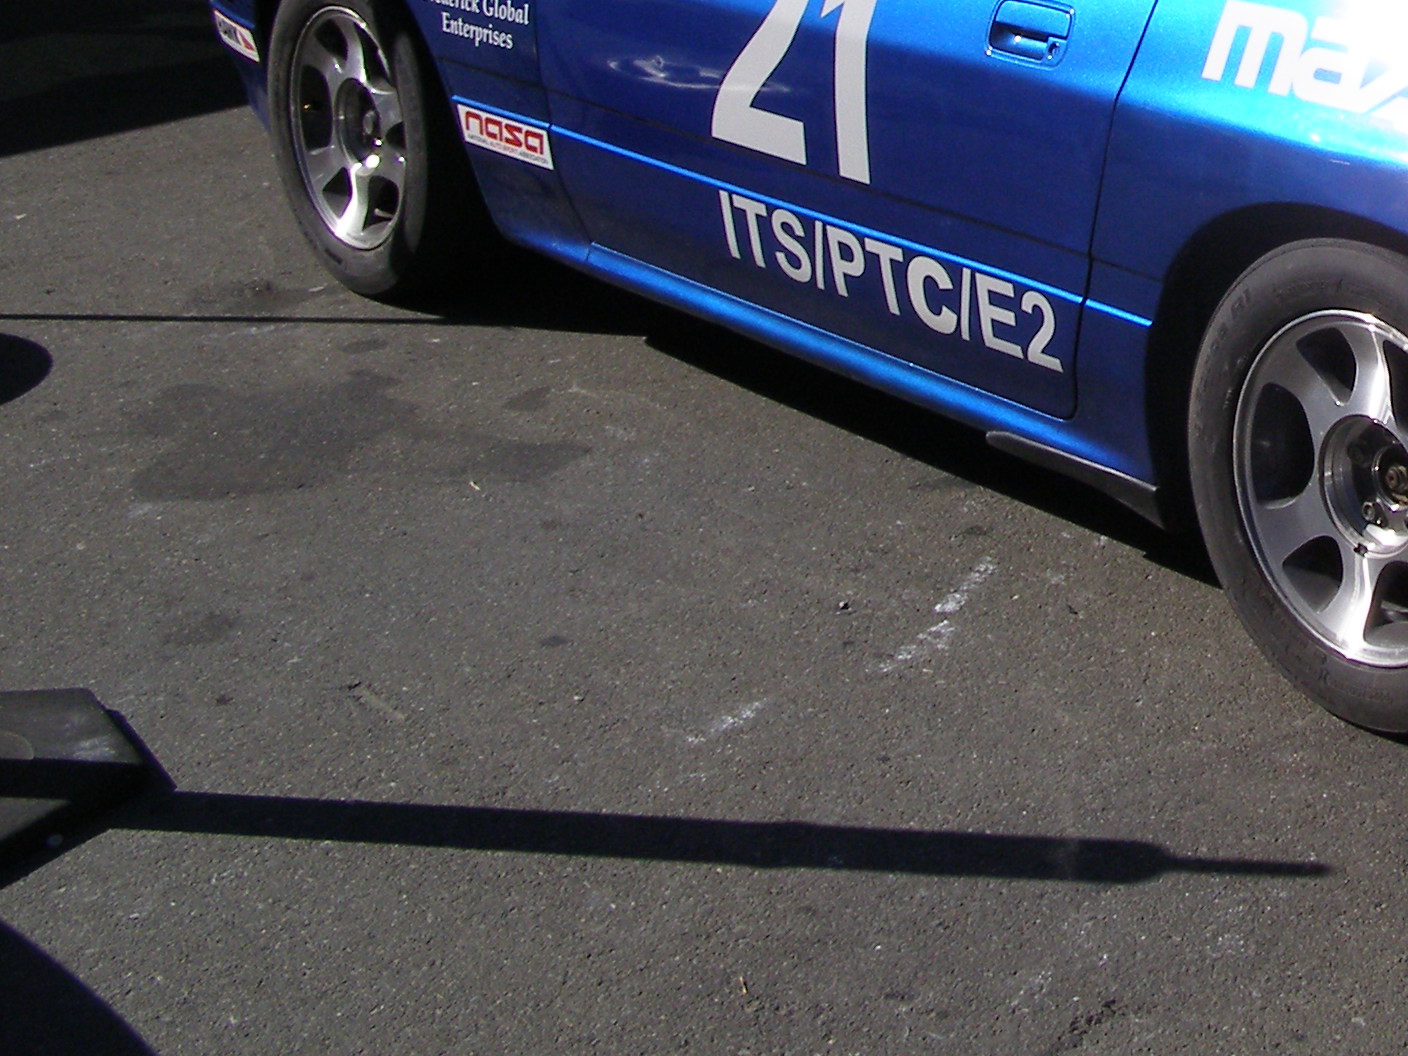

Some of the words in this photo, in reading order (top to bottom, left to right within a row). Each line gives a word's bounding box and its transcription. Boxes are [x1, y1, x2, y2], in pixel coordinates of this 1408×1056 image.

[441, 11, 514, 50] Enterprises
[465, 110, 544, 156] nasa
[717, 189, 1064, 373] ITS/PTC/E2
